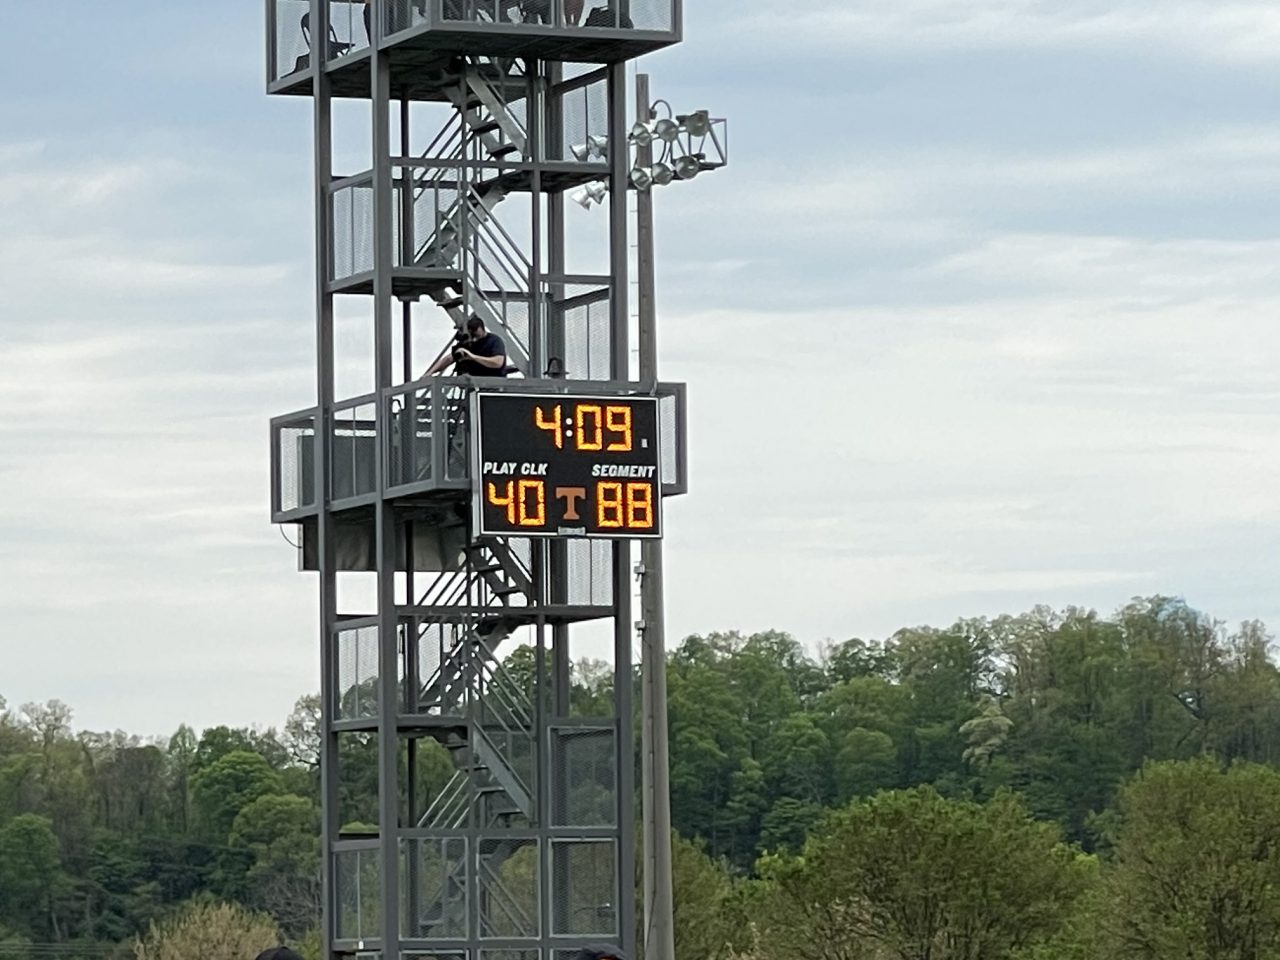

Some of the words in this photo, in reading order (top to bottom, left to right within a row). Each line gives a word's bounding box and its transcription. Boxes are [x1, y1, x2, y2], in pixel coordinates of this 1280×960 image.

[483, 462, 517, 475] PLAY
[520, 463, 548, 475] CLK
[592, 464, 656, 478] SEGMENT
[488, 479, 545, 526] 40
[555, 487, 586, 520] T
[596, 481, 654, 528] 88
